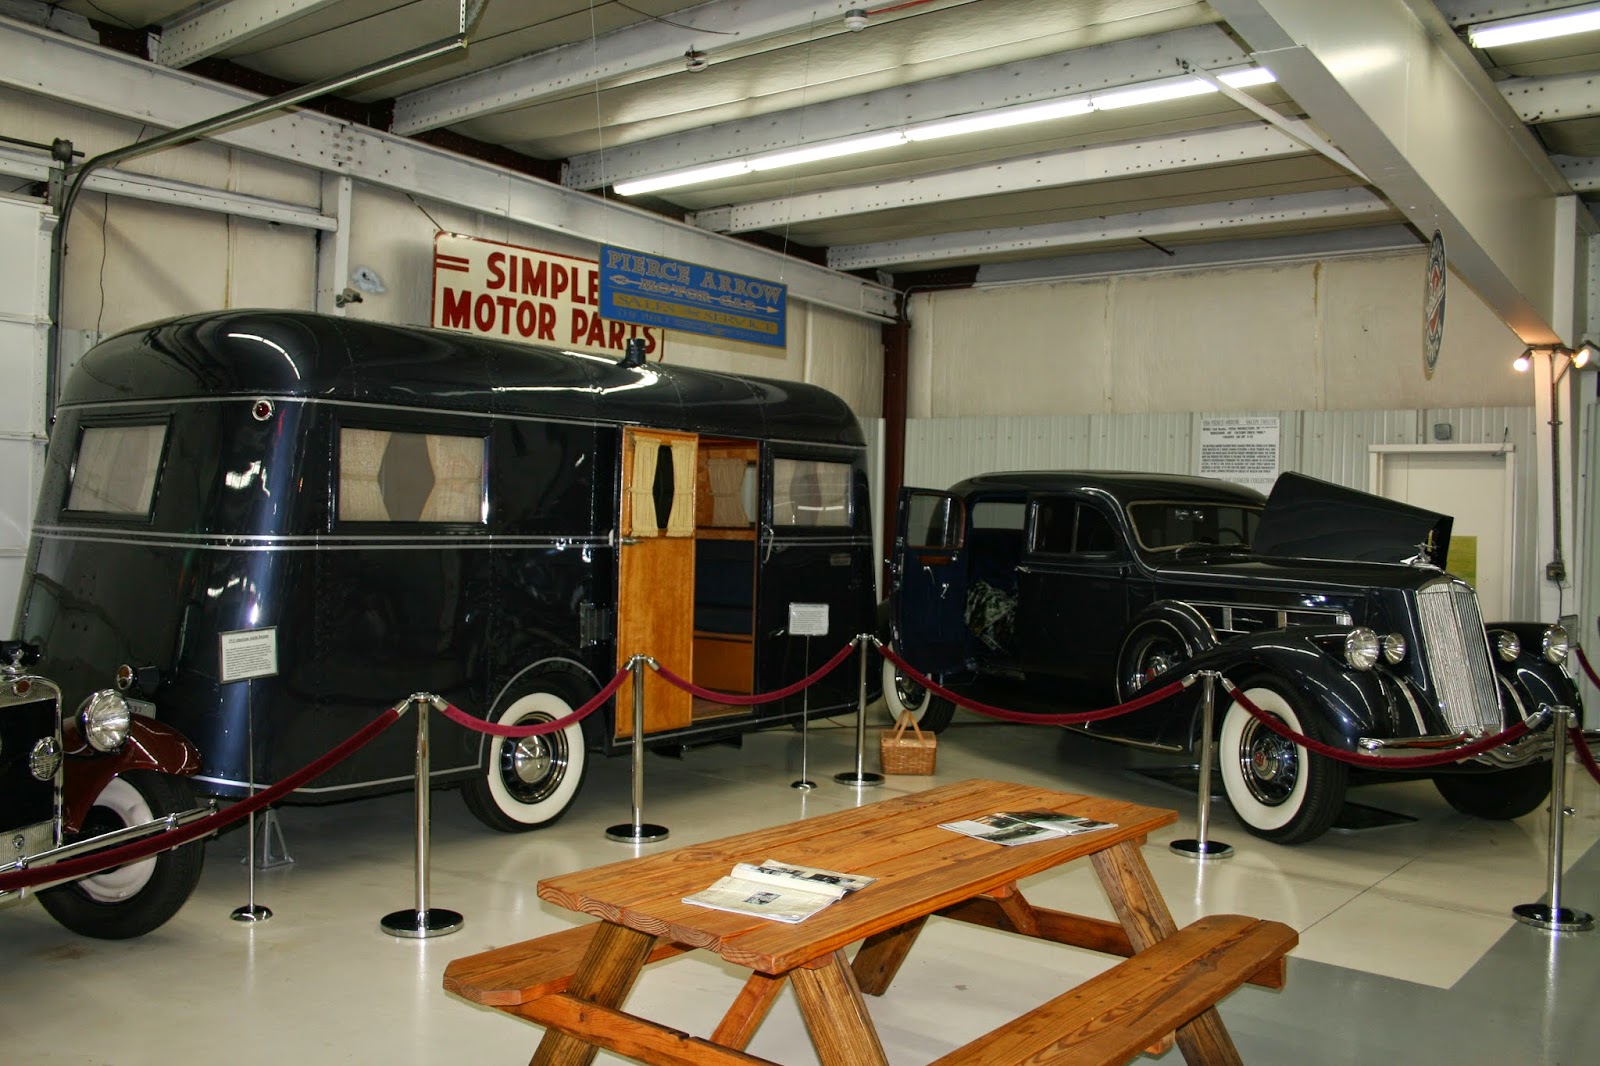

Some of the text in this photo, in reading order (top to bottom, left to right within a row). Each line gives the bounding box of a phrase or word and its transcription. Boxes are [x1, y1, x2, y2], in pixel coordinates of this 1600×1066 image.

[606, 249, 782, 305] PIERCE ARROW
[639, 278, 757, 312] MOTOR CAR
[442, 287, 555, 341] MOTOR
[571, 308, 656, 354] PARTS
[618, 296, 675, 313] SALES
[704, 312, 777, 331] SERVICE
